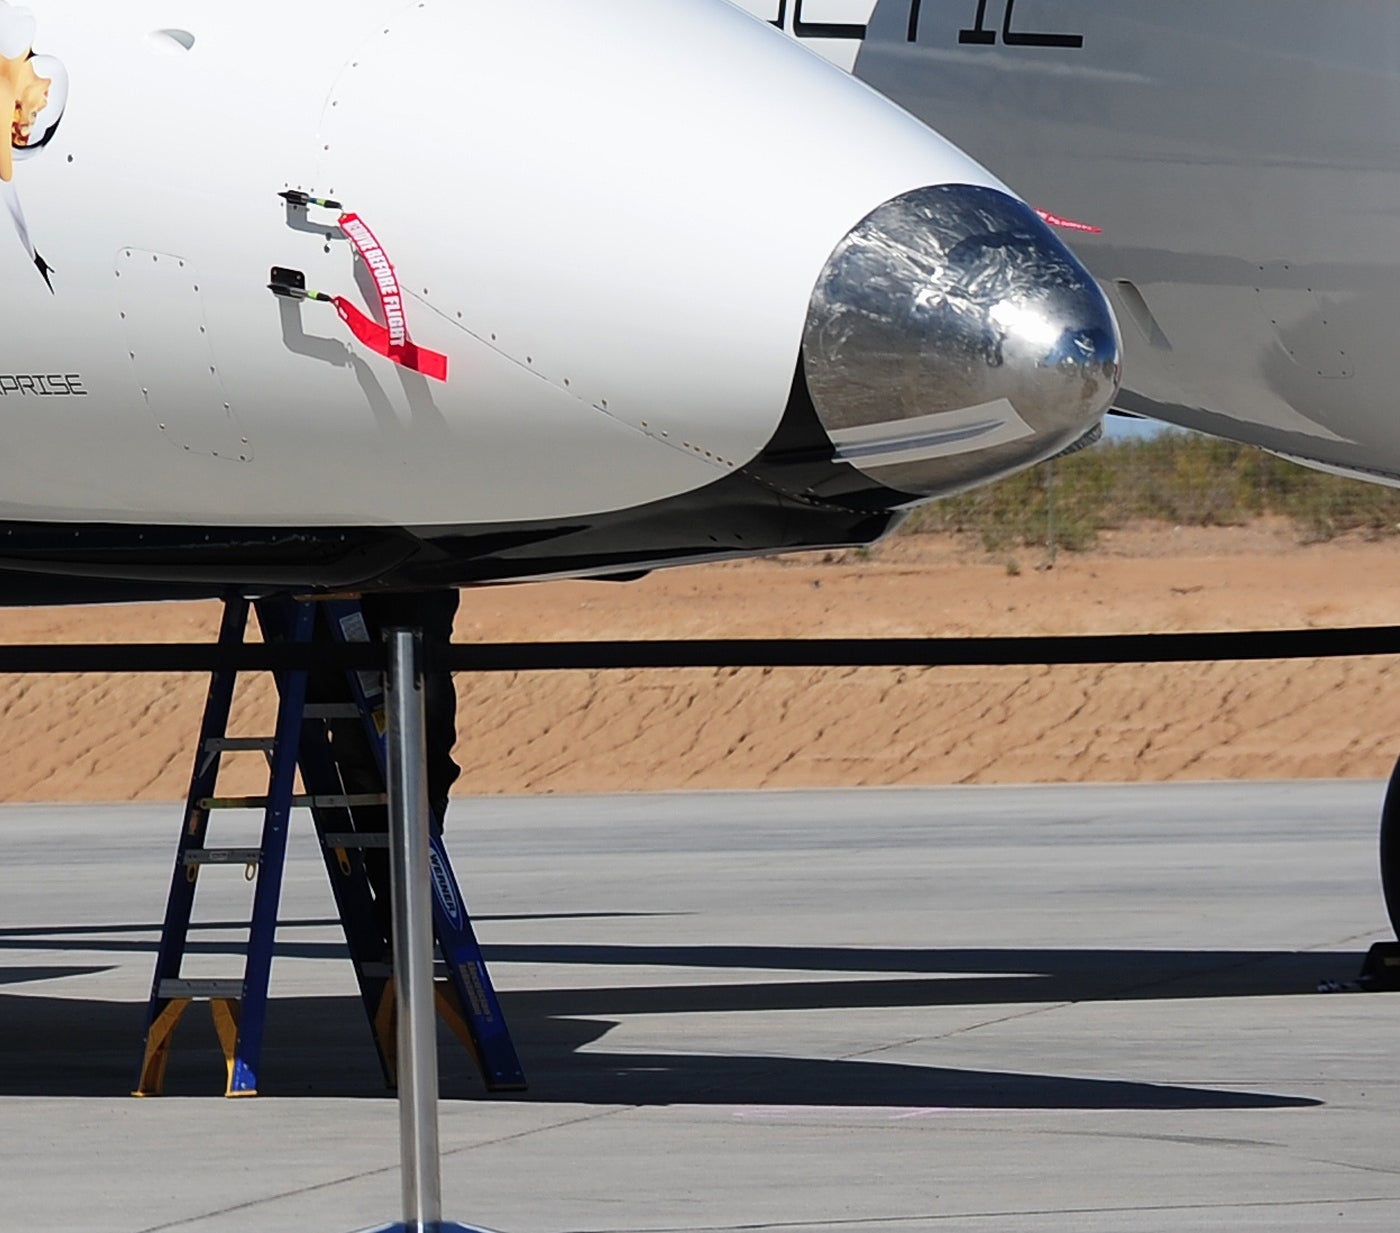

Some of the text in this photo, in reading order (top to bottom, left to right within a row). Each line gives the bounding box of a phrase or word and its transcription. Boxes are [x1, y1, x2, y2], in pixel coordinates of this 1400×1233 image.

[362, 248, 399, 295] BEFORE
[382, 295, 406, 347] FLIGHT
[430, 854, 456, 913] WERNER
